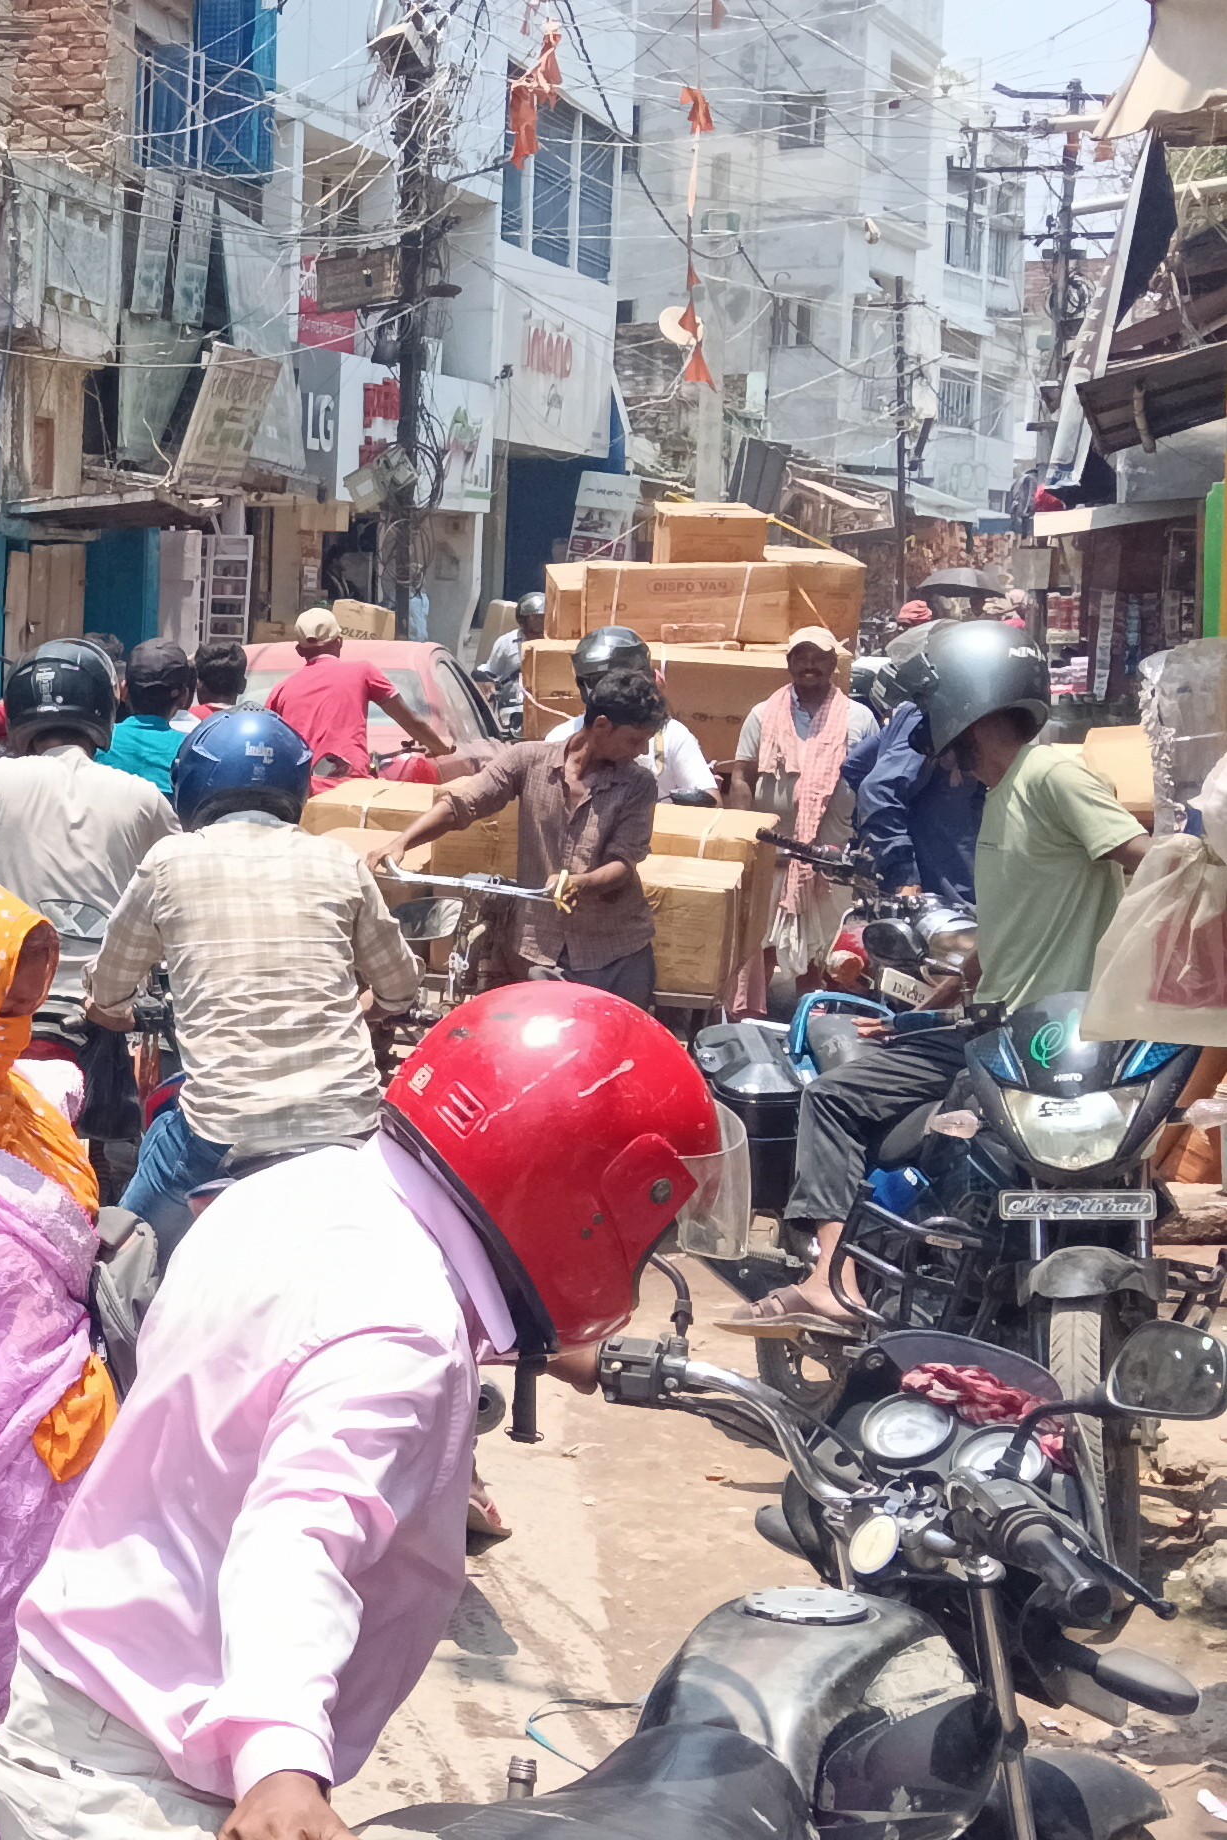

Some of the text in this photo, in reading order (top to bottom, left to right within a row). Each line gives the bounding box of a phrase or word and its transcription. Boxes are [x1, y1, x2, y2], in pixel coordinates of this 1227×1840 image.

[307, 391, 335, 453] LG
[653, 582, 728, 593] DISPO VAN
[340, 625, 377, 640] OLTAS
